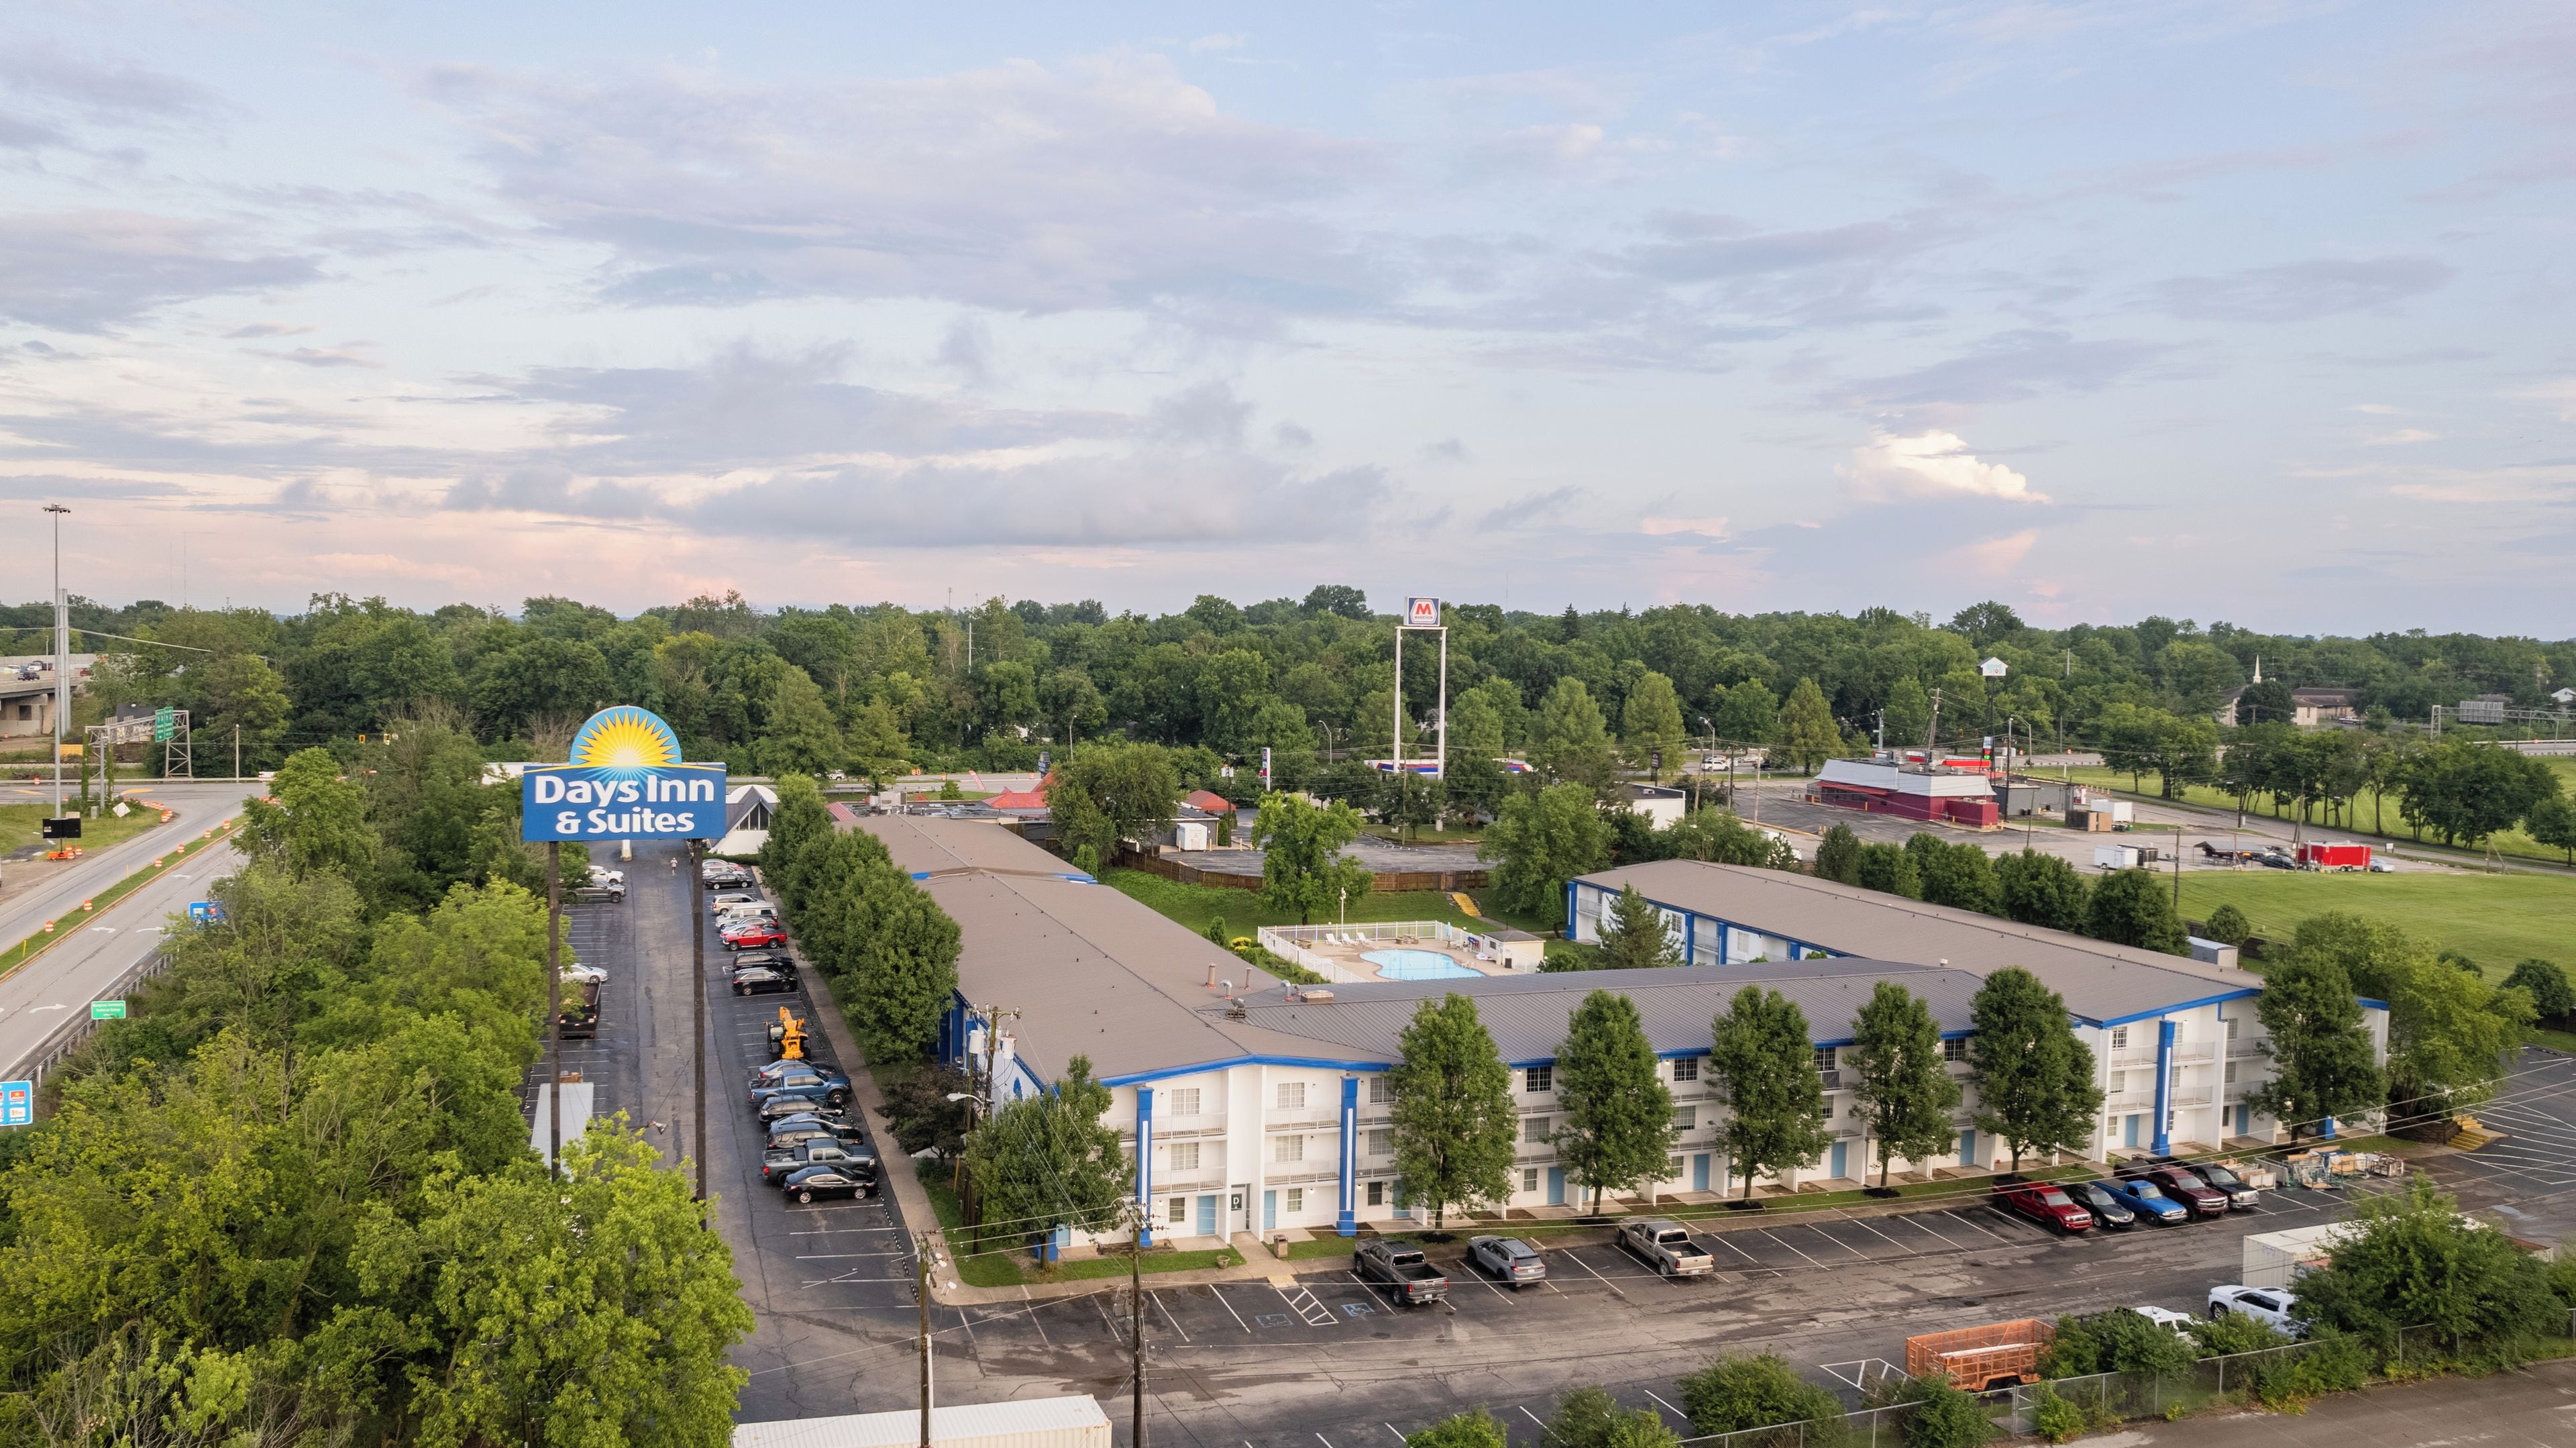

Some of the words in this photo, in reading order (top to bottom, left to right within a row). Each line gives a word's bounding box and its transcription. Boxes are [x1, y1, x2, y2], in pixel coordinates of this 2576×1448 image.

[1415, 603, 1432, 615] M
[535, 775, 639, 807] Days
[647, 774, 714, 803] Inn
[555, 811, 581, 834] &
[587, 806, 695, 834] Suites
[1233, 1196, 1240, 1205] D
